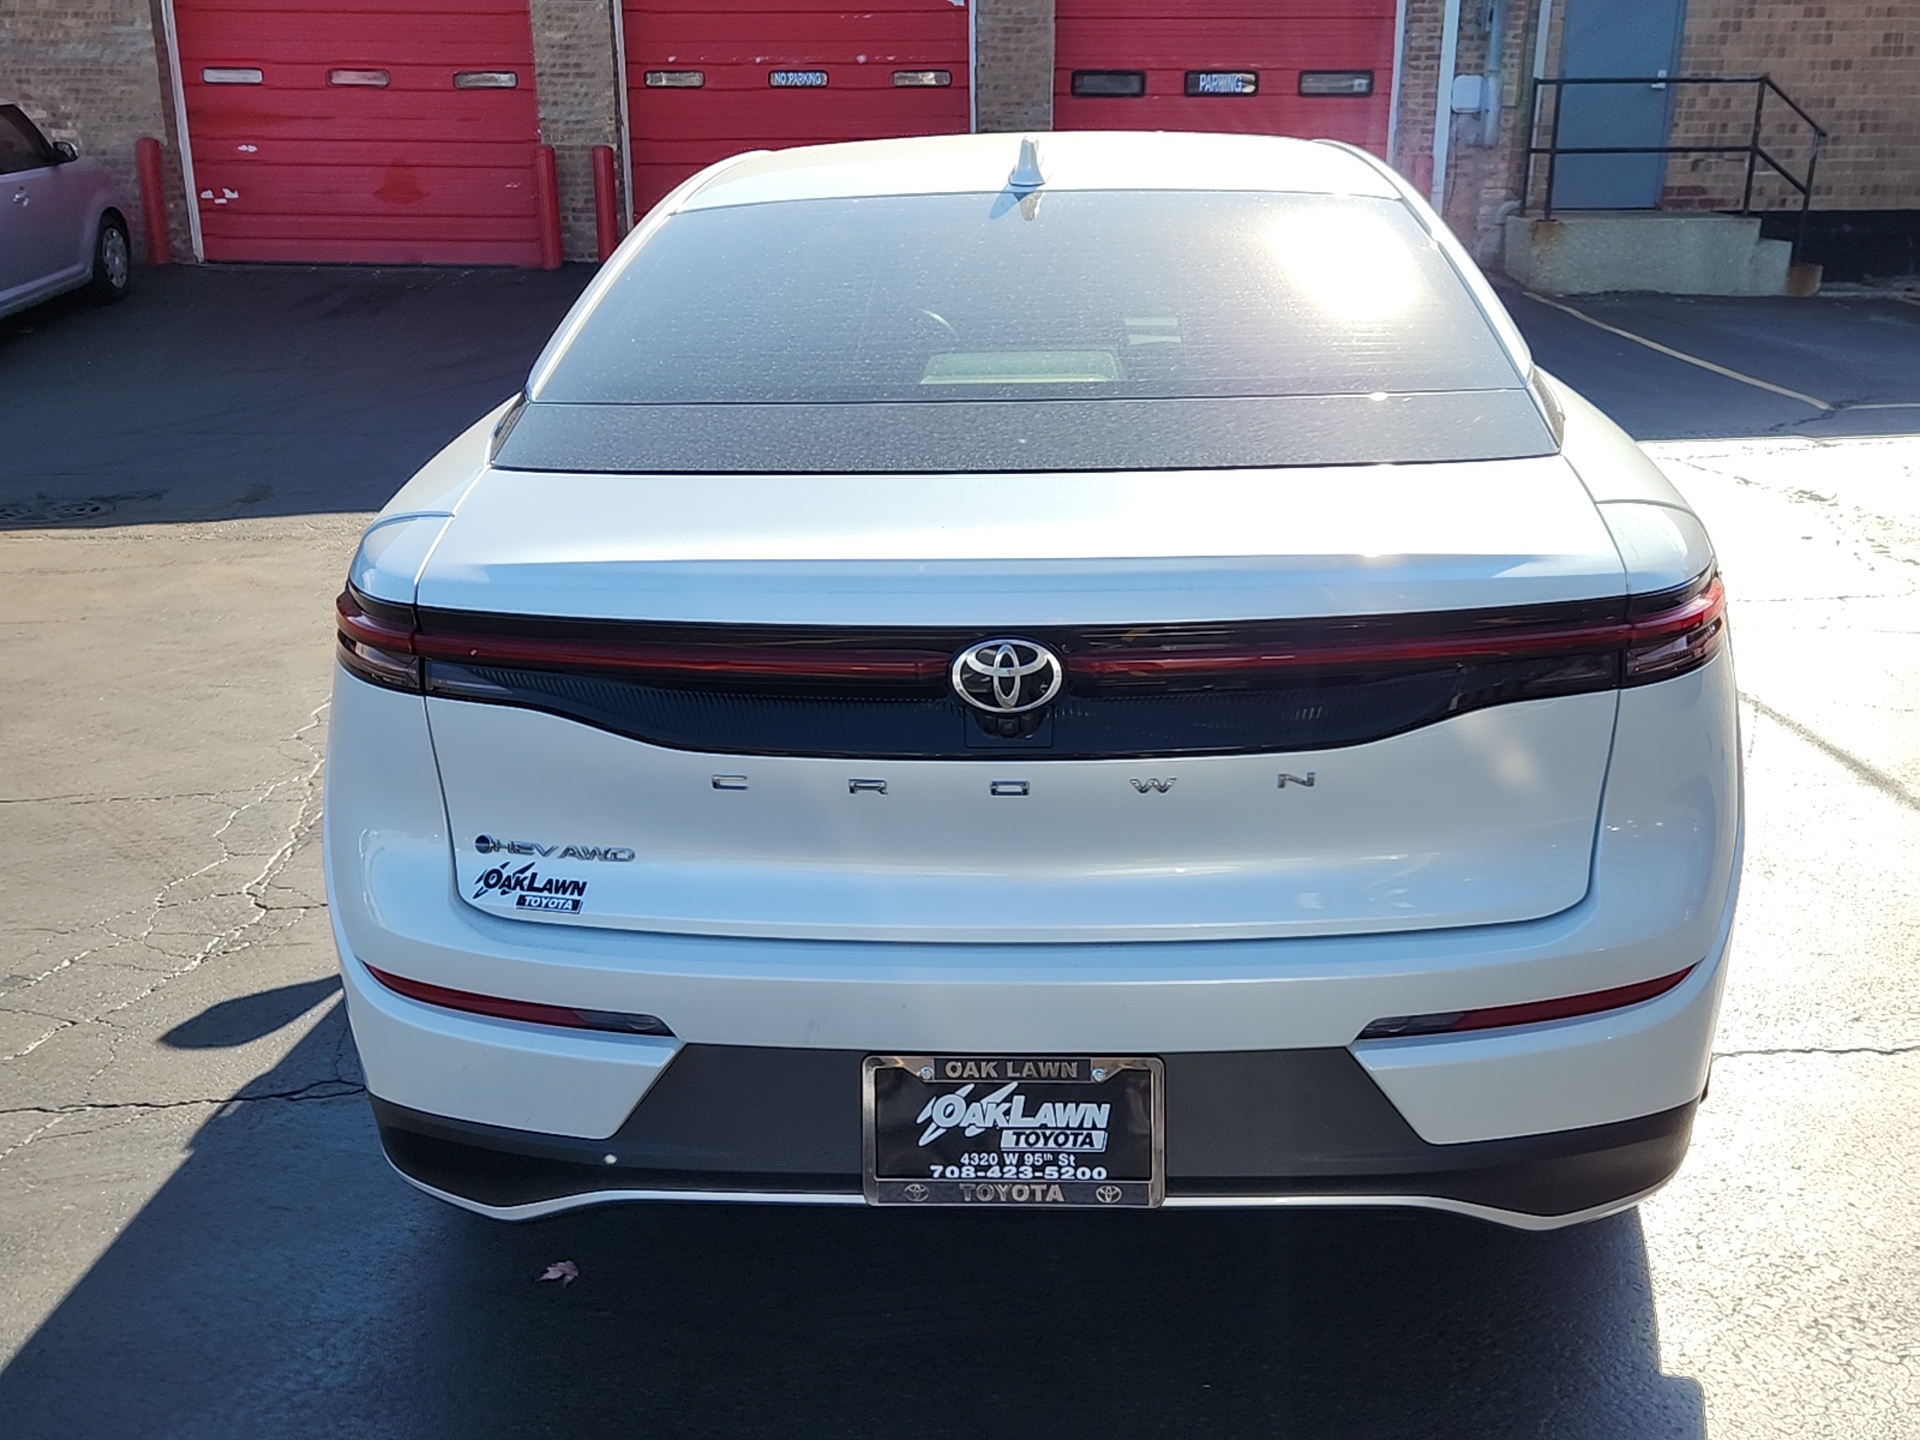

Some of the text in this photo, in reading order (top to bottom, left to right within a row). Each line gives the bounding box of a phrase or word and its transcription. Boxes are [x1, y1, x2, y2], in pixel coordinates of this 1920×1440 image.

[774, 72, 822, 86] NO PARKING
[711, 771, 1316, 797] CROWN
[557, 844, 636, 863] AWD
[524, 896, 574, 910] TOYOTA
[945, 1060, 1079, 1079] OAK LAWN
[1012, 1131, 1095, 1148] TOYOTA
[960, 1152, 1076, 1167] 4320 W 95th St
[929, 1164, 1108, 1180] 708-423-5200
[959, 1183, 1065, 1202] TOYOTA
